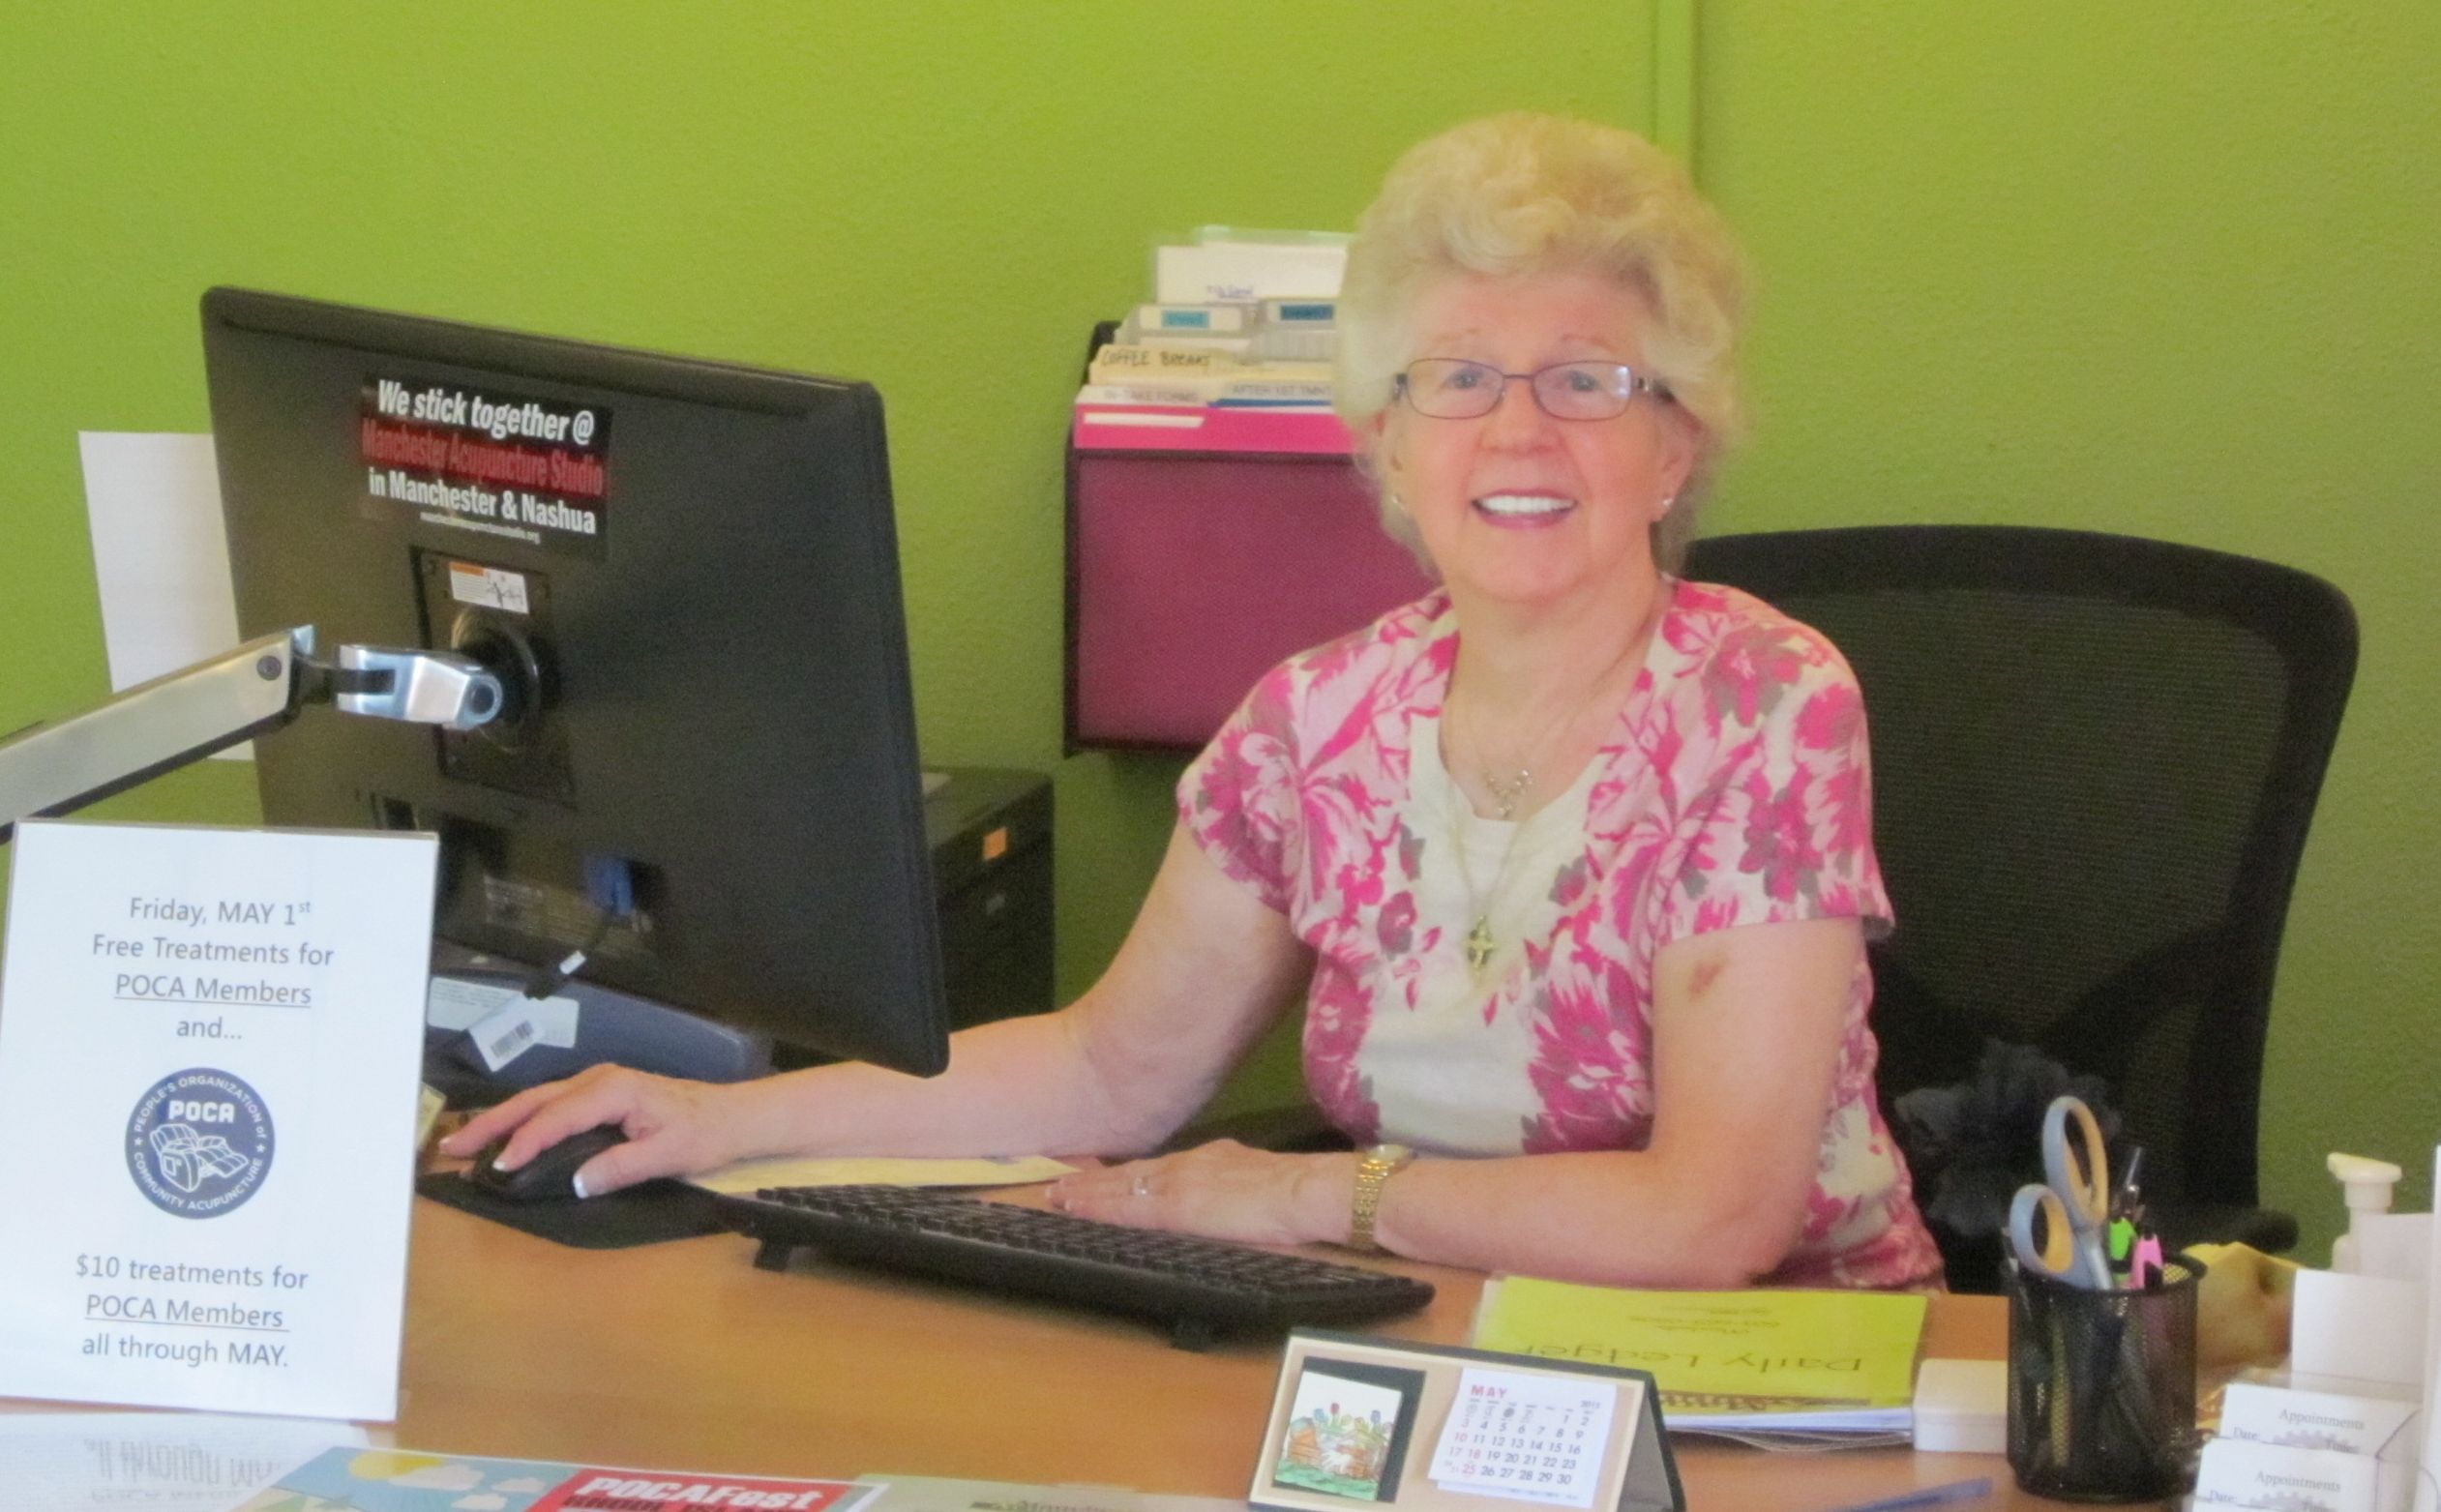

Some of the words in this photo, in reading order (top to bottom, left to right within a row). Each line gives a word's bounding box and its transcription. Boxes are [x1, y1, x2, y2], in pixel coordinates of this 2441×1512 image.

[1101, 349, 1150, 367] COFFEE
[379, 379, 410, 415] We
[414, 389, 467, 425] stick
[471, 396, 570, 441] together
[573, 410, 594, 445] @
[363, 418, 448, 468] Manchester
[449, 432, 548, 487] Acupuncture
[551, 449, 603, 495] Studio
[370, 466, 385, 495] in
[389, 470, 497, 517] Manchester
[501, 490, 518, 519] &
[522, 493, 596, 534] Nashua
[130, 897, 207, 927] Friday,
[218, 902, 275, 925] MAY
[283, 902, 311, 925] 1st
[93, 934, 143, 958] Free
[153, 936, 289, 964] Treatments
[299, 942, 334, 965] for
[115, 973, 186, 997] POCA
[194, 977, 312, 1004] Members
[176, 1017, 242, 1039] and...
[134, 1082, 176, 1132] PEOPLE'S
[178, 1076, 263, 1122] ORGANIZATION
[168, 1100, 234, 1123] POCA
[134, 1152, 185, 1207] COMMUNITY
[188, 1158, 263, 1210] ACUPUNCTURE
[75, 1254, 120, 1278] $10
[129, 1260, 263, 1287] treatments
[273, 1265, 309, 1289] for
[87, 1294, 157, 1319] POCA
[166, 1298, 283, 1327] Members
[82, 1333, 109, 1355] all
[119, 1335, 219, 1368] through
[228, 1343, 288, 1367] MAY.
[1515, 1344, 1700, 1368] Ledger
[1726, 1353, 1862, 1373] Daily
[1471, 1385, 1507, 1398] MAY
[1480, 1420, 1488, 1430] 4
[1499, 1422, 1507, 1432] 5
[1518, 1425, 1525, 1434] 6
[1537, 1426, 1545, 1435] 7
[1556, 1428, 1563, 1438] 8
[1575, 1430, 1584, 1439] 9
[1563, 1414, 1569, 1424] 1
[1581, 1416, 1590, 1426] 2
[2279, 1408, 2365, 1430] Appointments
[1454, 1433, 1469, 1442] 10
[1474, 1434, 1485, 1443] 11
[1492, 1436, 1505, 1446] 12
[1511, 1438, 1524, 1448] 13
[1531, 1439, 1544, 1450] 14
[1549, 1441, 1562, 1453] 15
[1567, 1443, 1581, 1455] 16
[1449, 1447, 1463, 1457] 17
[1469, 1448, 1481, 1459] 18
[1487, 1450, 1500, 1461] 19
[1505, 1452, 1519, 1463] 20
[1524, 1454, 1536, 1465] 21
[1542, 1457, 1558, 1467] 22
[1562, 1459, 1576, 1469] 23
[1463, 1464, 1476, 1474] 25
[1480, 1466, 1495, 1476] 26
[1500, 1468, 1515, 1478] 27
[1519, 1469, 1533, 1480] 28
[1537, 1472, 1552, 1482] 29
[1557, 1474, 1571, 1484] 30
[2255, 1470, 2341, 1492] Appointments
[575, 1477, 821, 1509] POCAFest
